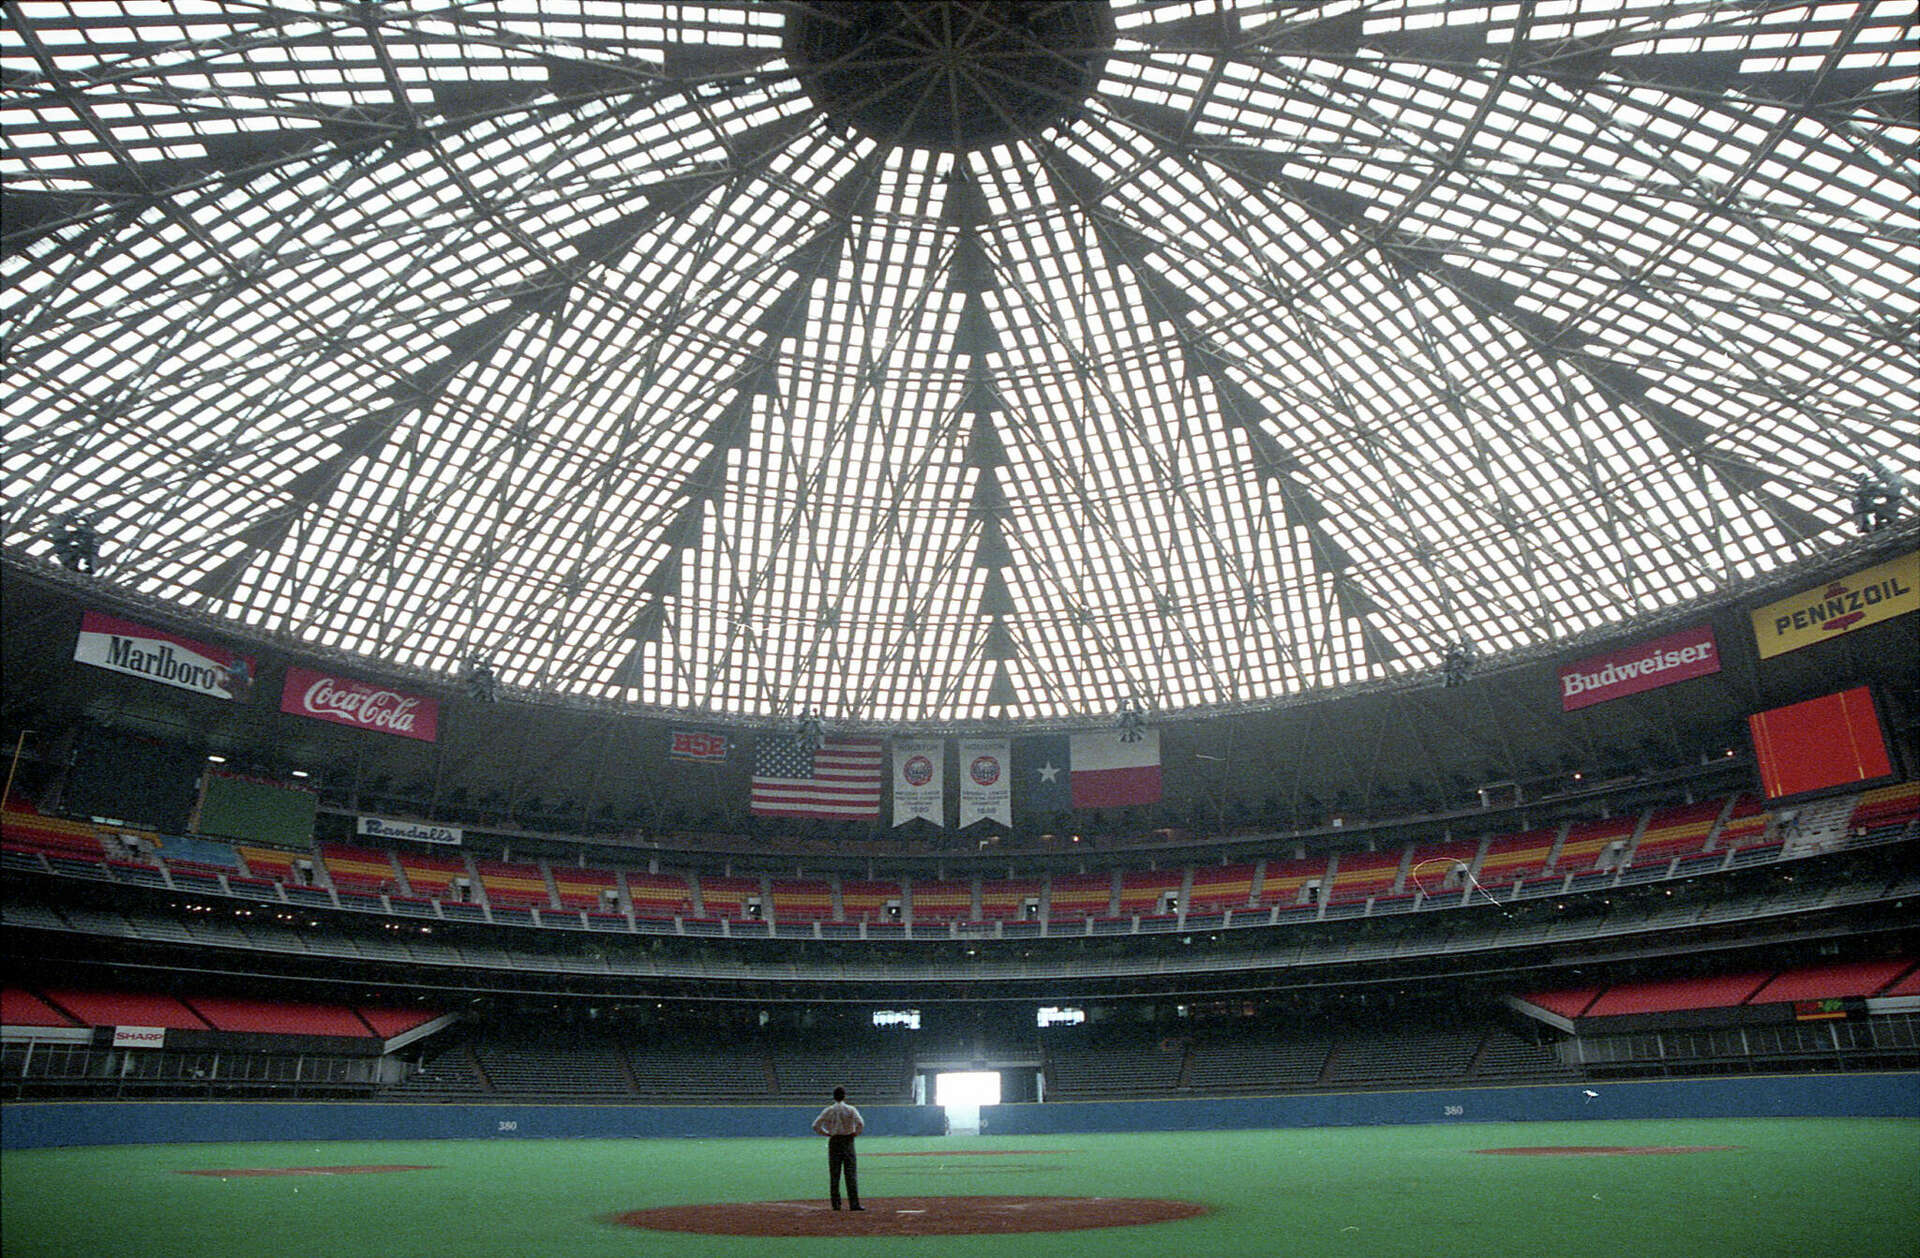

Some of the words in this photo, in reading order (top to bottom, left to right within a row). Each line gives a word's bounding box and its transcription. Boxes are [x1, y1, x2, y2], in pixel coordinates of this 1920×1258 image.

[1776, 578, 1910, 635] PENNZOIL
[105, 636, 215, 689] Marlboro
[1561, 642, 1712, 696] Budweiser
[304, 679, 421, 731] Coca-Cola
[115, 1032, 164, 1041] SHARP
[497, 1120, 518, 1131] 380
[1443, 1105, 1464, 1116] 380
